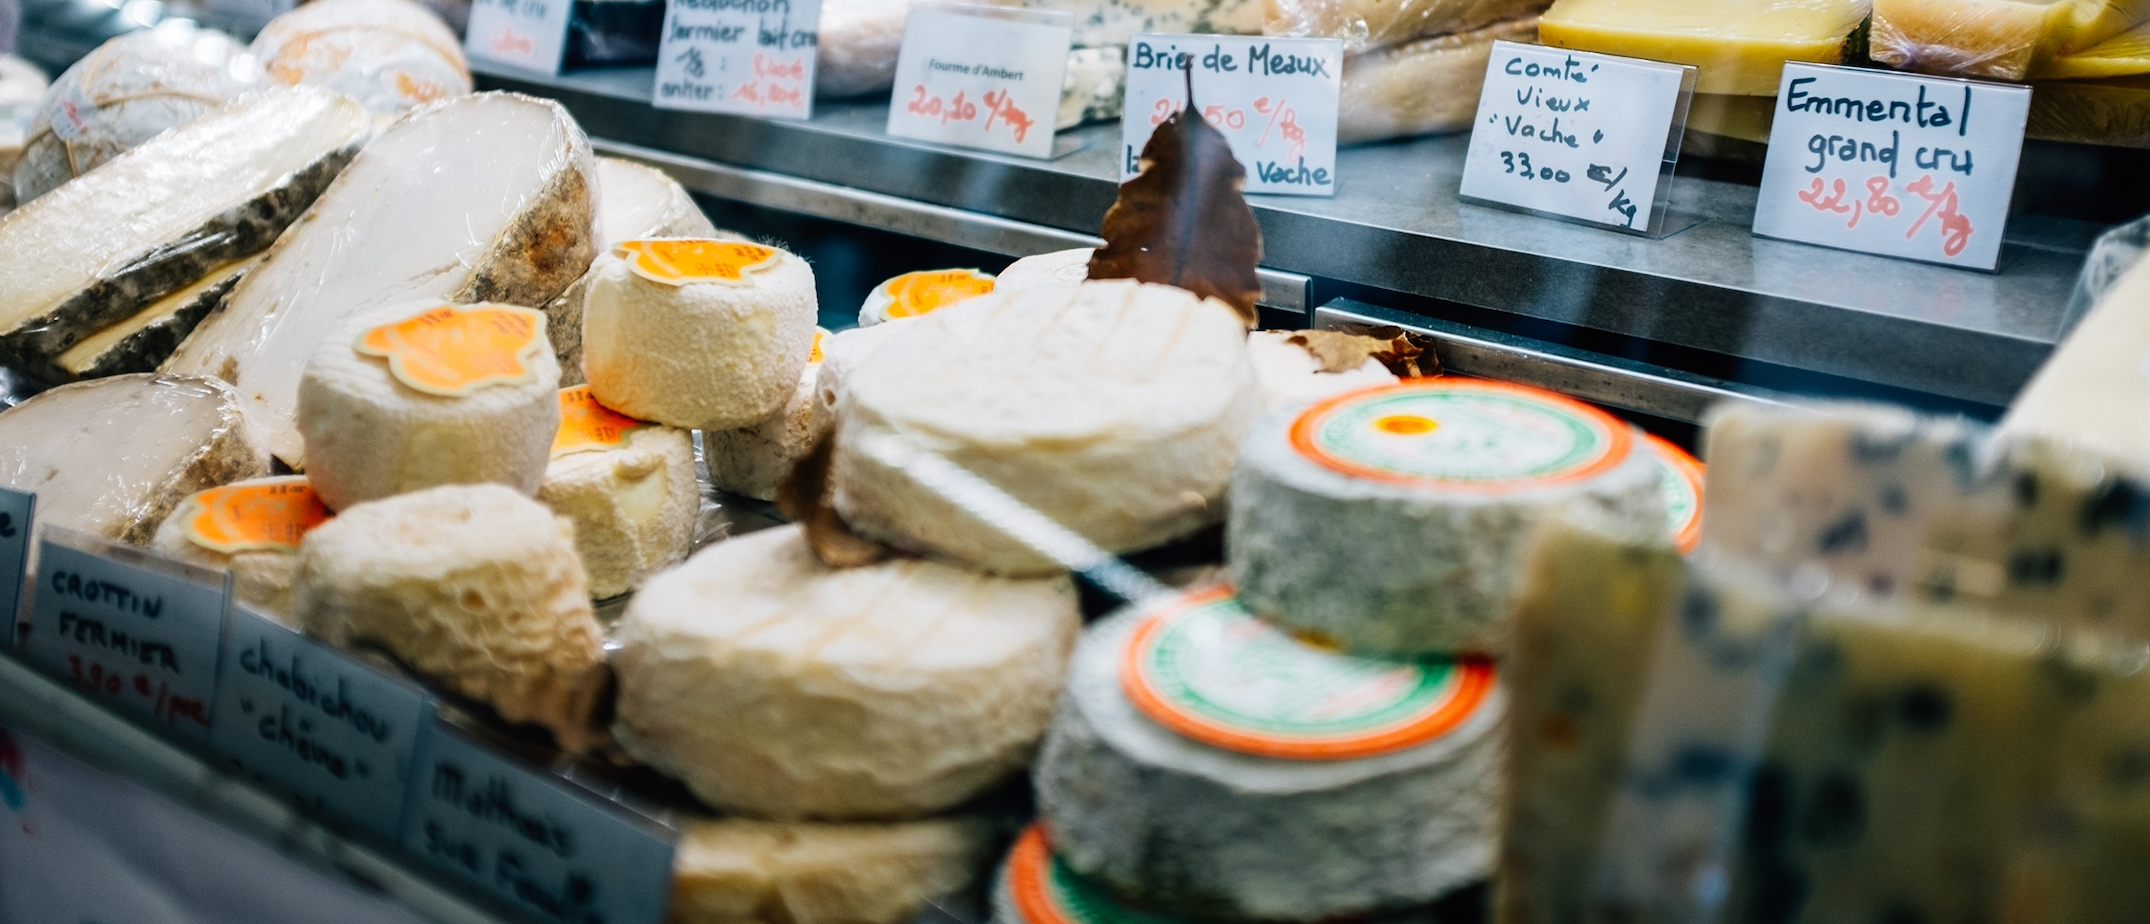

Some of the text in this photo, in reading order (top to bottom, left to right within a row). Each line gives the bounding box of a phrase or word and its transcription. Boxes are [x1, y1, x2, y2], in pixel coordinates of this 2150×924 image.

[929, 59, 1025, 82] Fourme d'Ambert
[1133, 42, 1331, 79] Brie de Meaux
[1517, 86, 1590, 112] Vieux
[1787, 77, 1972, 136] Emmental
[1500, 151, 1571, 183] 33,00
[1805, 130, 1973, 178] grand cru
[1798, 176, 1900, 228] 22,80
[52, 571, 163, 619] CROTTIN
[59, 611, 180, 674] FERMIER
